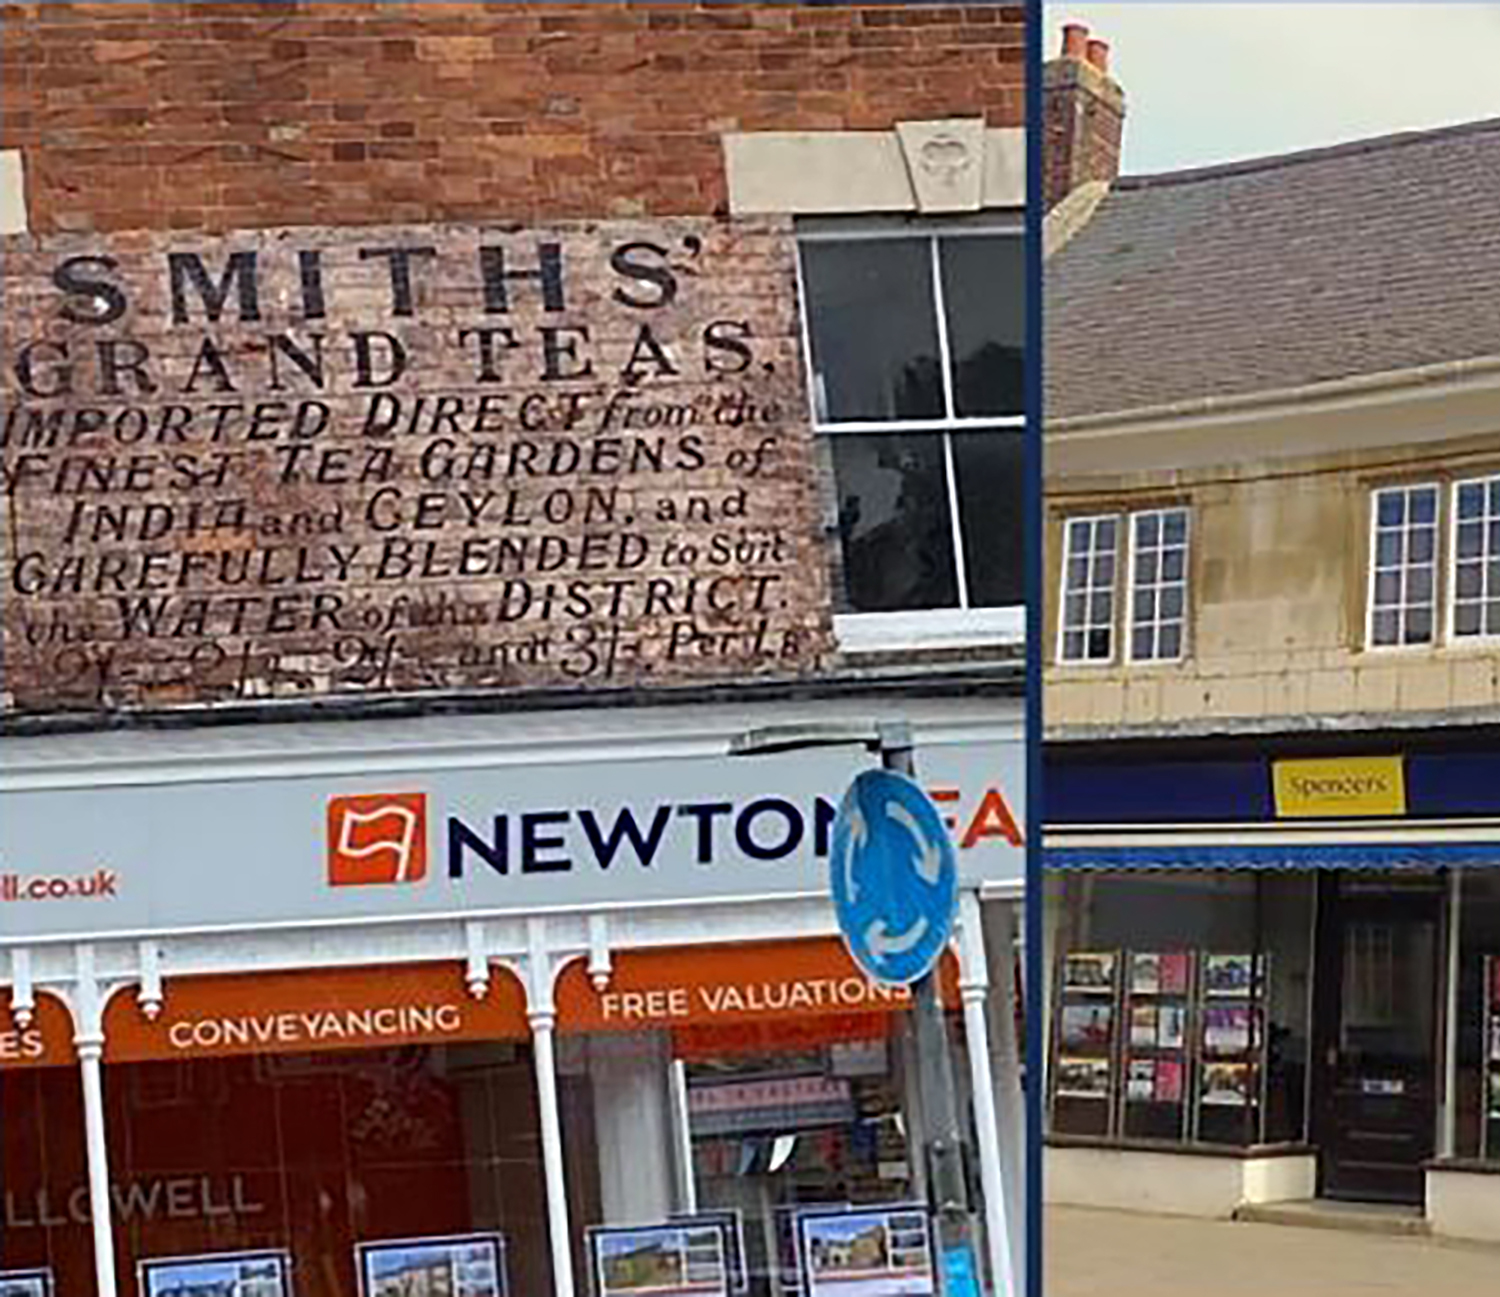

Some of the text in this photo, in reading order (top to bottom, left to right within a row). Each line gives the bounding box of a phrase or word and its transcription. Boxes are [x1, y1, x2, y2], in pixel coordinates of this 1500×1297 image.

[14, 324, 406, 398] GRAND
[0, 401, 330, 449] IMPORTED
[363, 391, 602, 438] DIRECT
[598, 390, 697, 434] from
[5, 434, 777, 497] FINEST TEA GARDENS of
[62, 498, 247, 544] INDIA
[260, 501, 343, 537] and
[655, 484, 748, 525] and
[376, 533, 649, 579] BLENDED
[660, 538, 699, 568] to
[118, 592, 346, 640] WATER
[1288, 773, 1391, 799] Spencers
[169, 1004, 462, 1049] CONVEYANCING
[601, 988, 689, 1021] FREE
